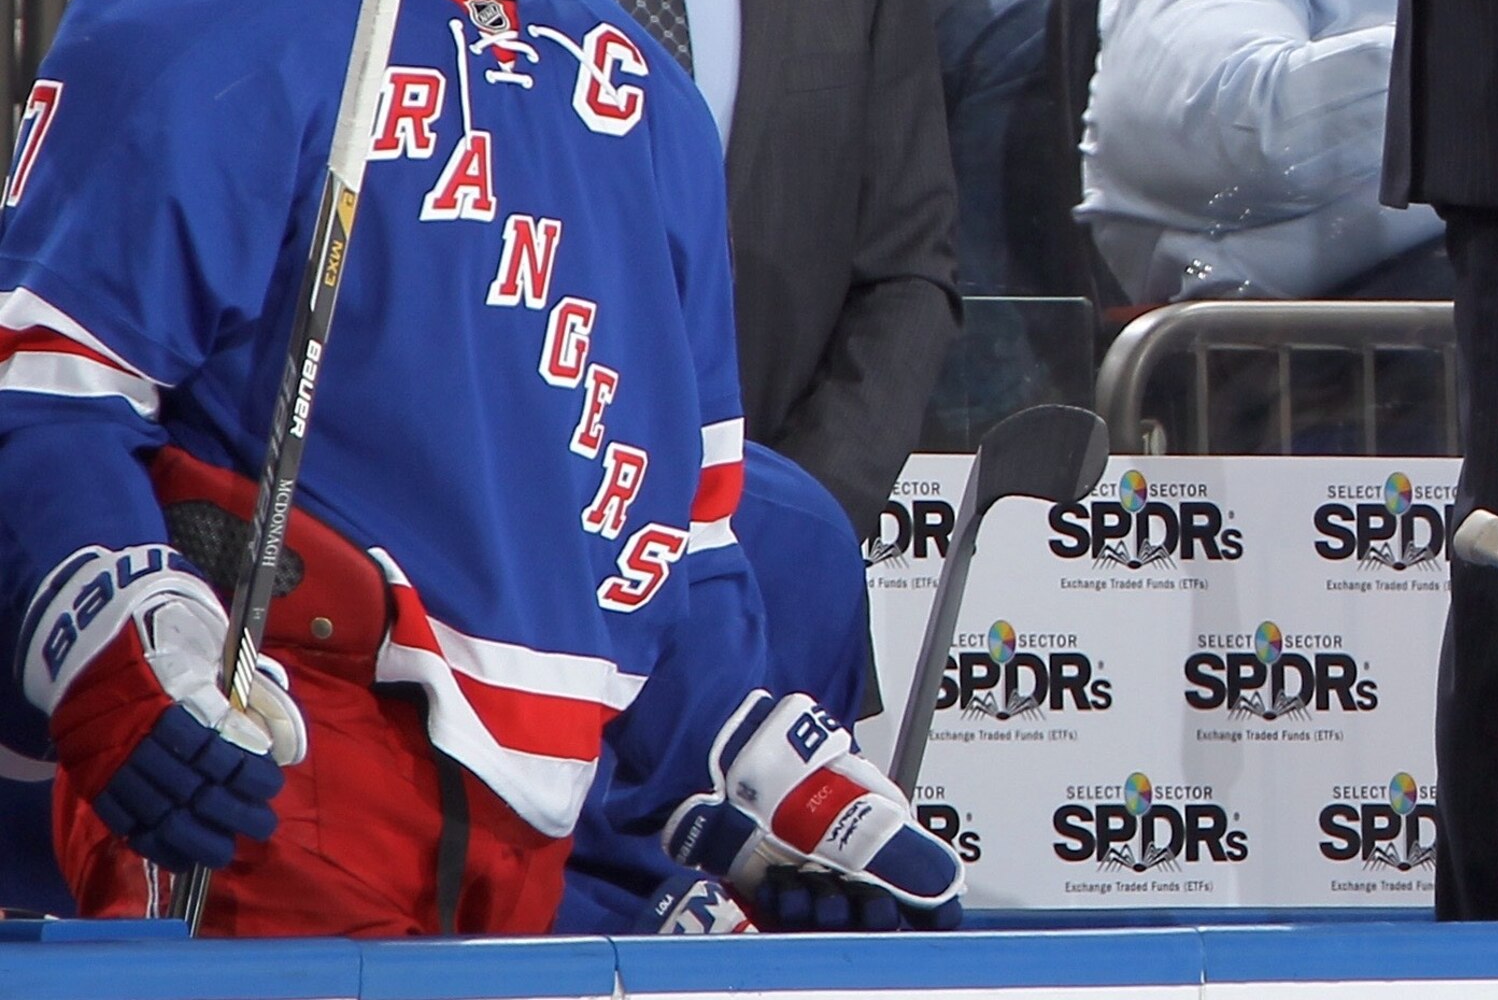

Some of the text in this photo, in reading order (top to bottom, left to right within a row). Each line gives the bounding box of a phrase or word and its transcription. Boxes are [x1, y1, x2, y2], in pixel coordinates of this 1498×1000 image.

[572, 22, 648, 136] C
[324, 239, 343, 287] MX3
[369, 66, 690, 612] RANGERS
[290, 339, 322, 438] BAUER
[893, 482, 941, 496] ECTOR
[1150, 483, 1208, 497] SECTOR
[1328, 486, 1457, 499] SELECT SECT
[911, 577, 938, 590] (ETFs
[1061, 578, 1208, 591] Exchange Traded Funds (ETFs)
[1326, 580, 1372, 593] Exchange
[1376, 580, 1408, 591] Traded
[1411, 580, 1440, 591] Funds
[951, 634, 1077, 647] LECT SECTOR
[1198, 635, 1342, 648] SELECT SECTOR
[979, 731, 1011, 741] Traded
[1015, 731, 1044, 741] Funds
[1048, 730, 1077, 742] (ETFs)
[1196, 730, 1343, 743] Exchange Traded Funds (ETFs)
[1066, 786, 1212, 799] SELECT SECTOR
[1333, 787, 1386, 799] SELECT
[1065, 881, 1213, 895] Exchange Traded Funds (ETFs)
[1331, 881, 1376, 893] Exchange
[1381, 880, 1412, 891] Traded
[655, 895, 675, 916] LOLA
